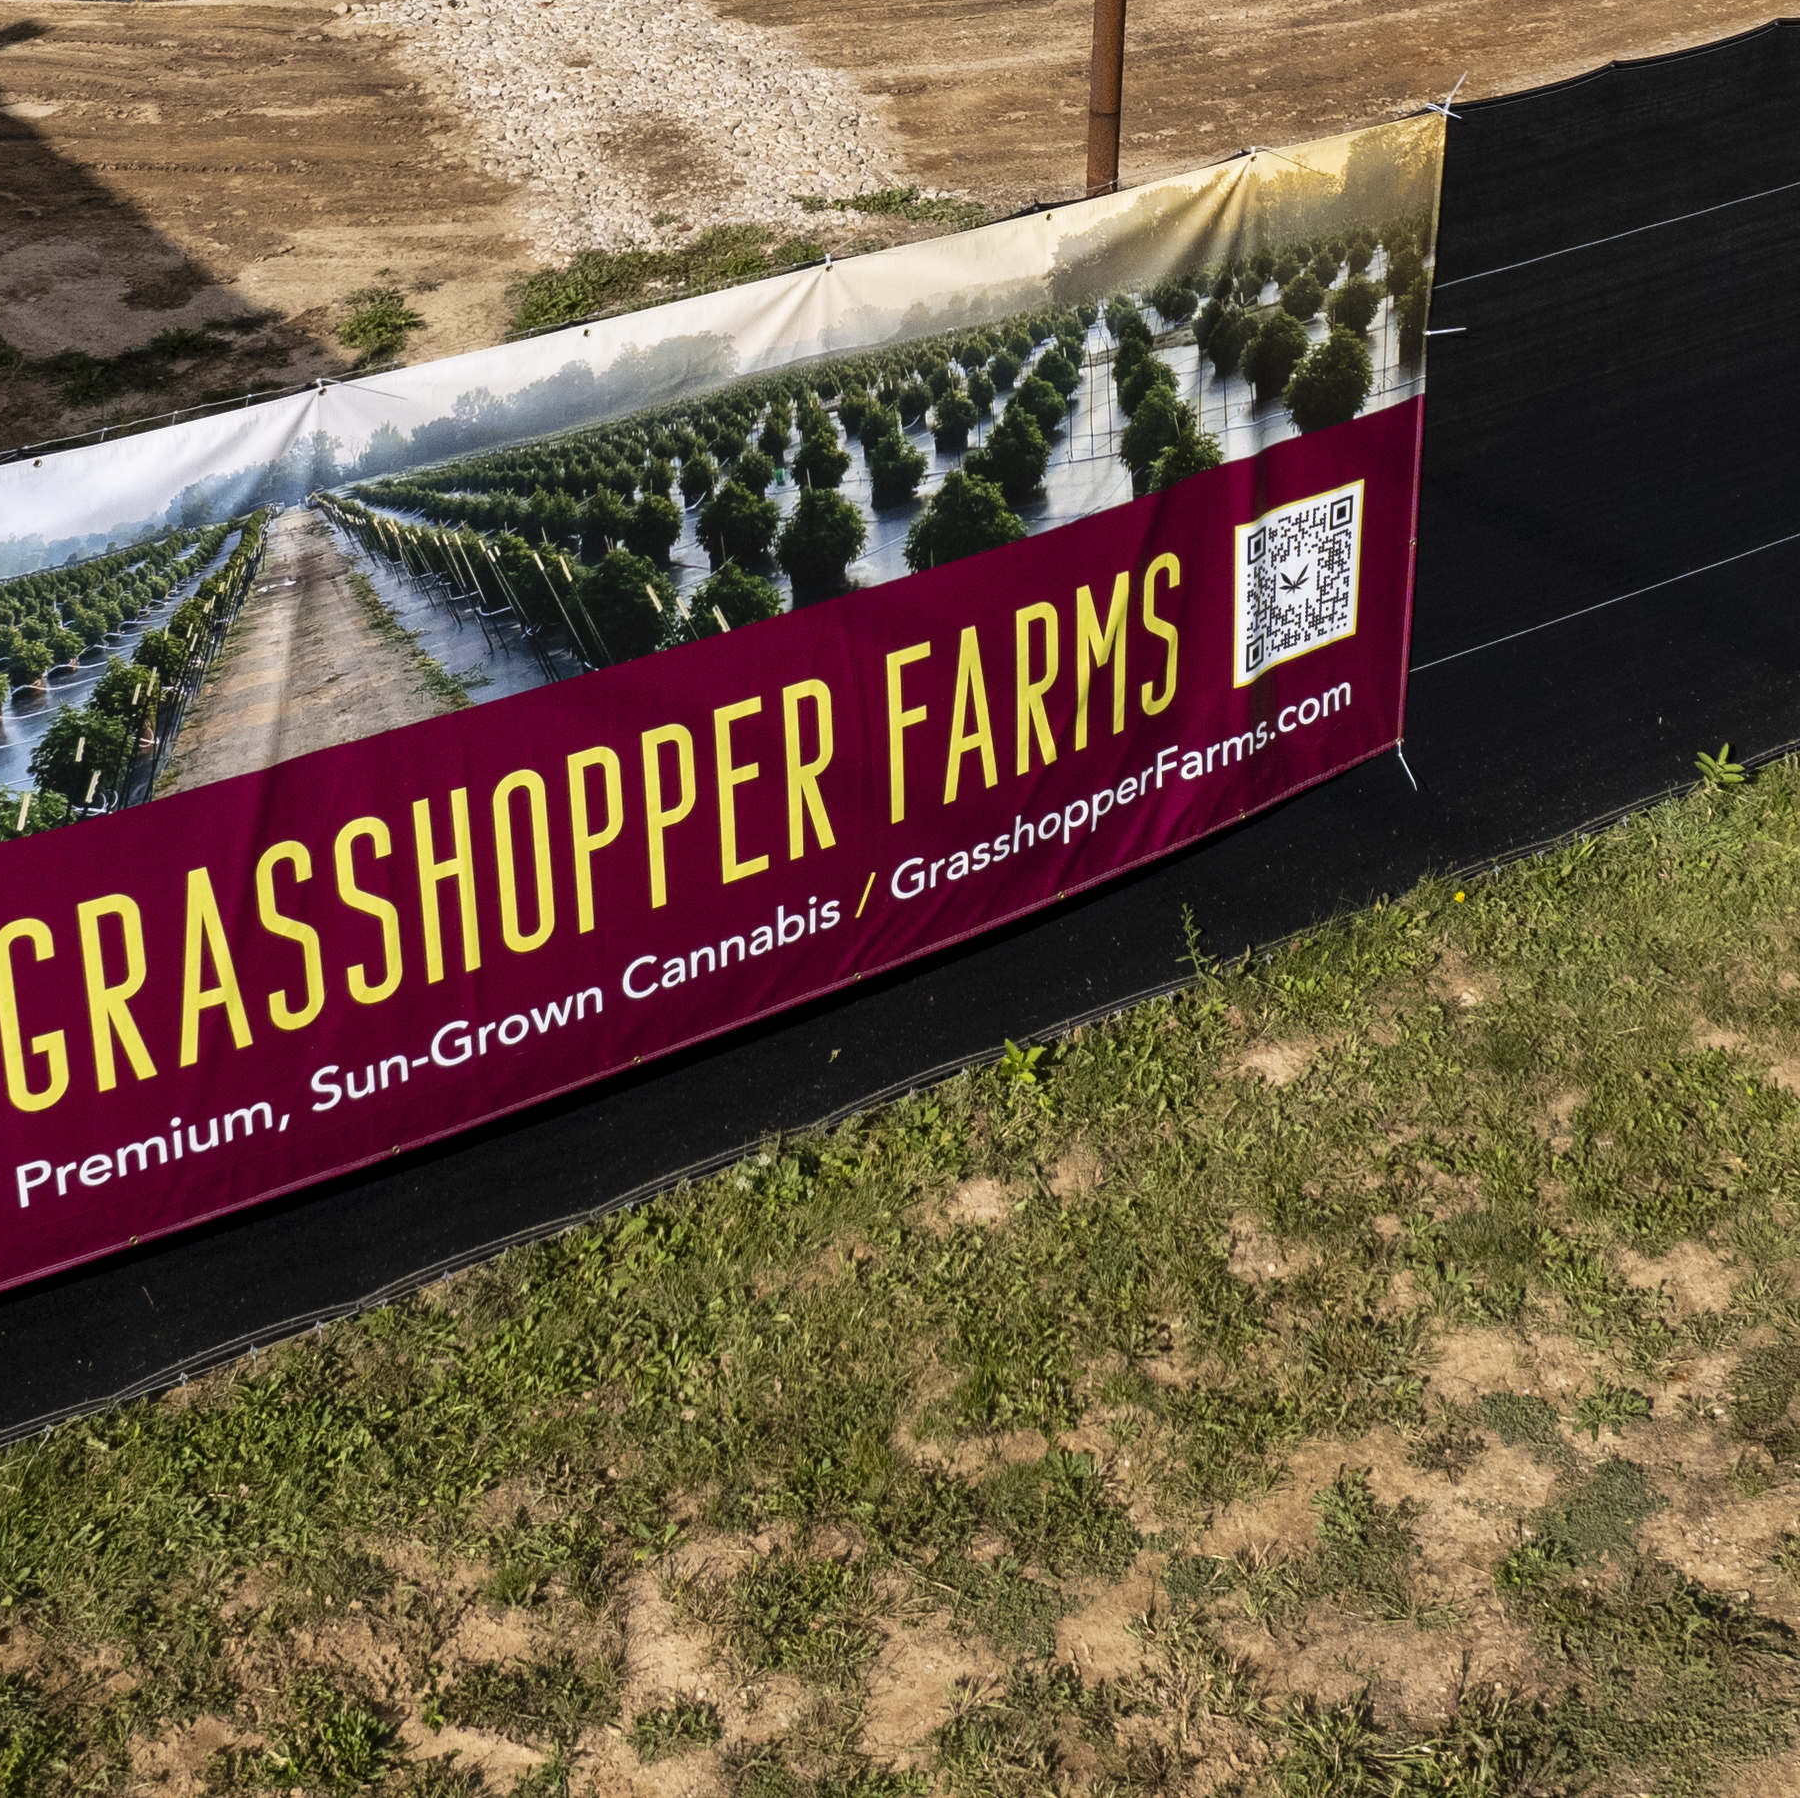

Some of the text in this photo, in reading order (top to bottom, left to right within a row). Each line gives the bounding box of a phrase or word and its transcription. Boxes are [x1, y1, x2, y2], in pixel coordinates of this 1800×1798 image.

[885, 551, 1182, 825] FARMS
[14, 1098, 292, 1210] Premium,
[309, 985, 604, 1113] Sun-Grown
[621, 894, 842, 1000] Cannabis
[889, 680, 1353, 901] GrasshopperFarms.com
